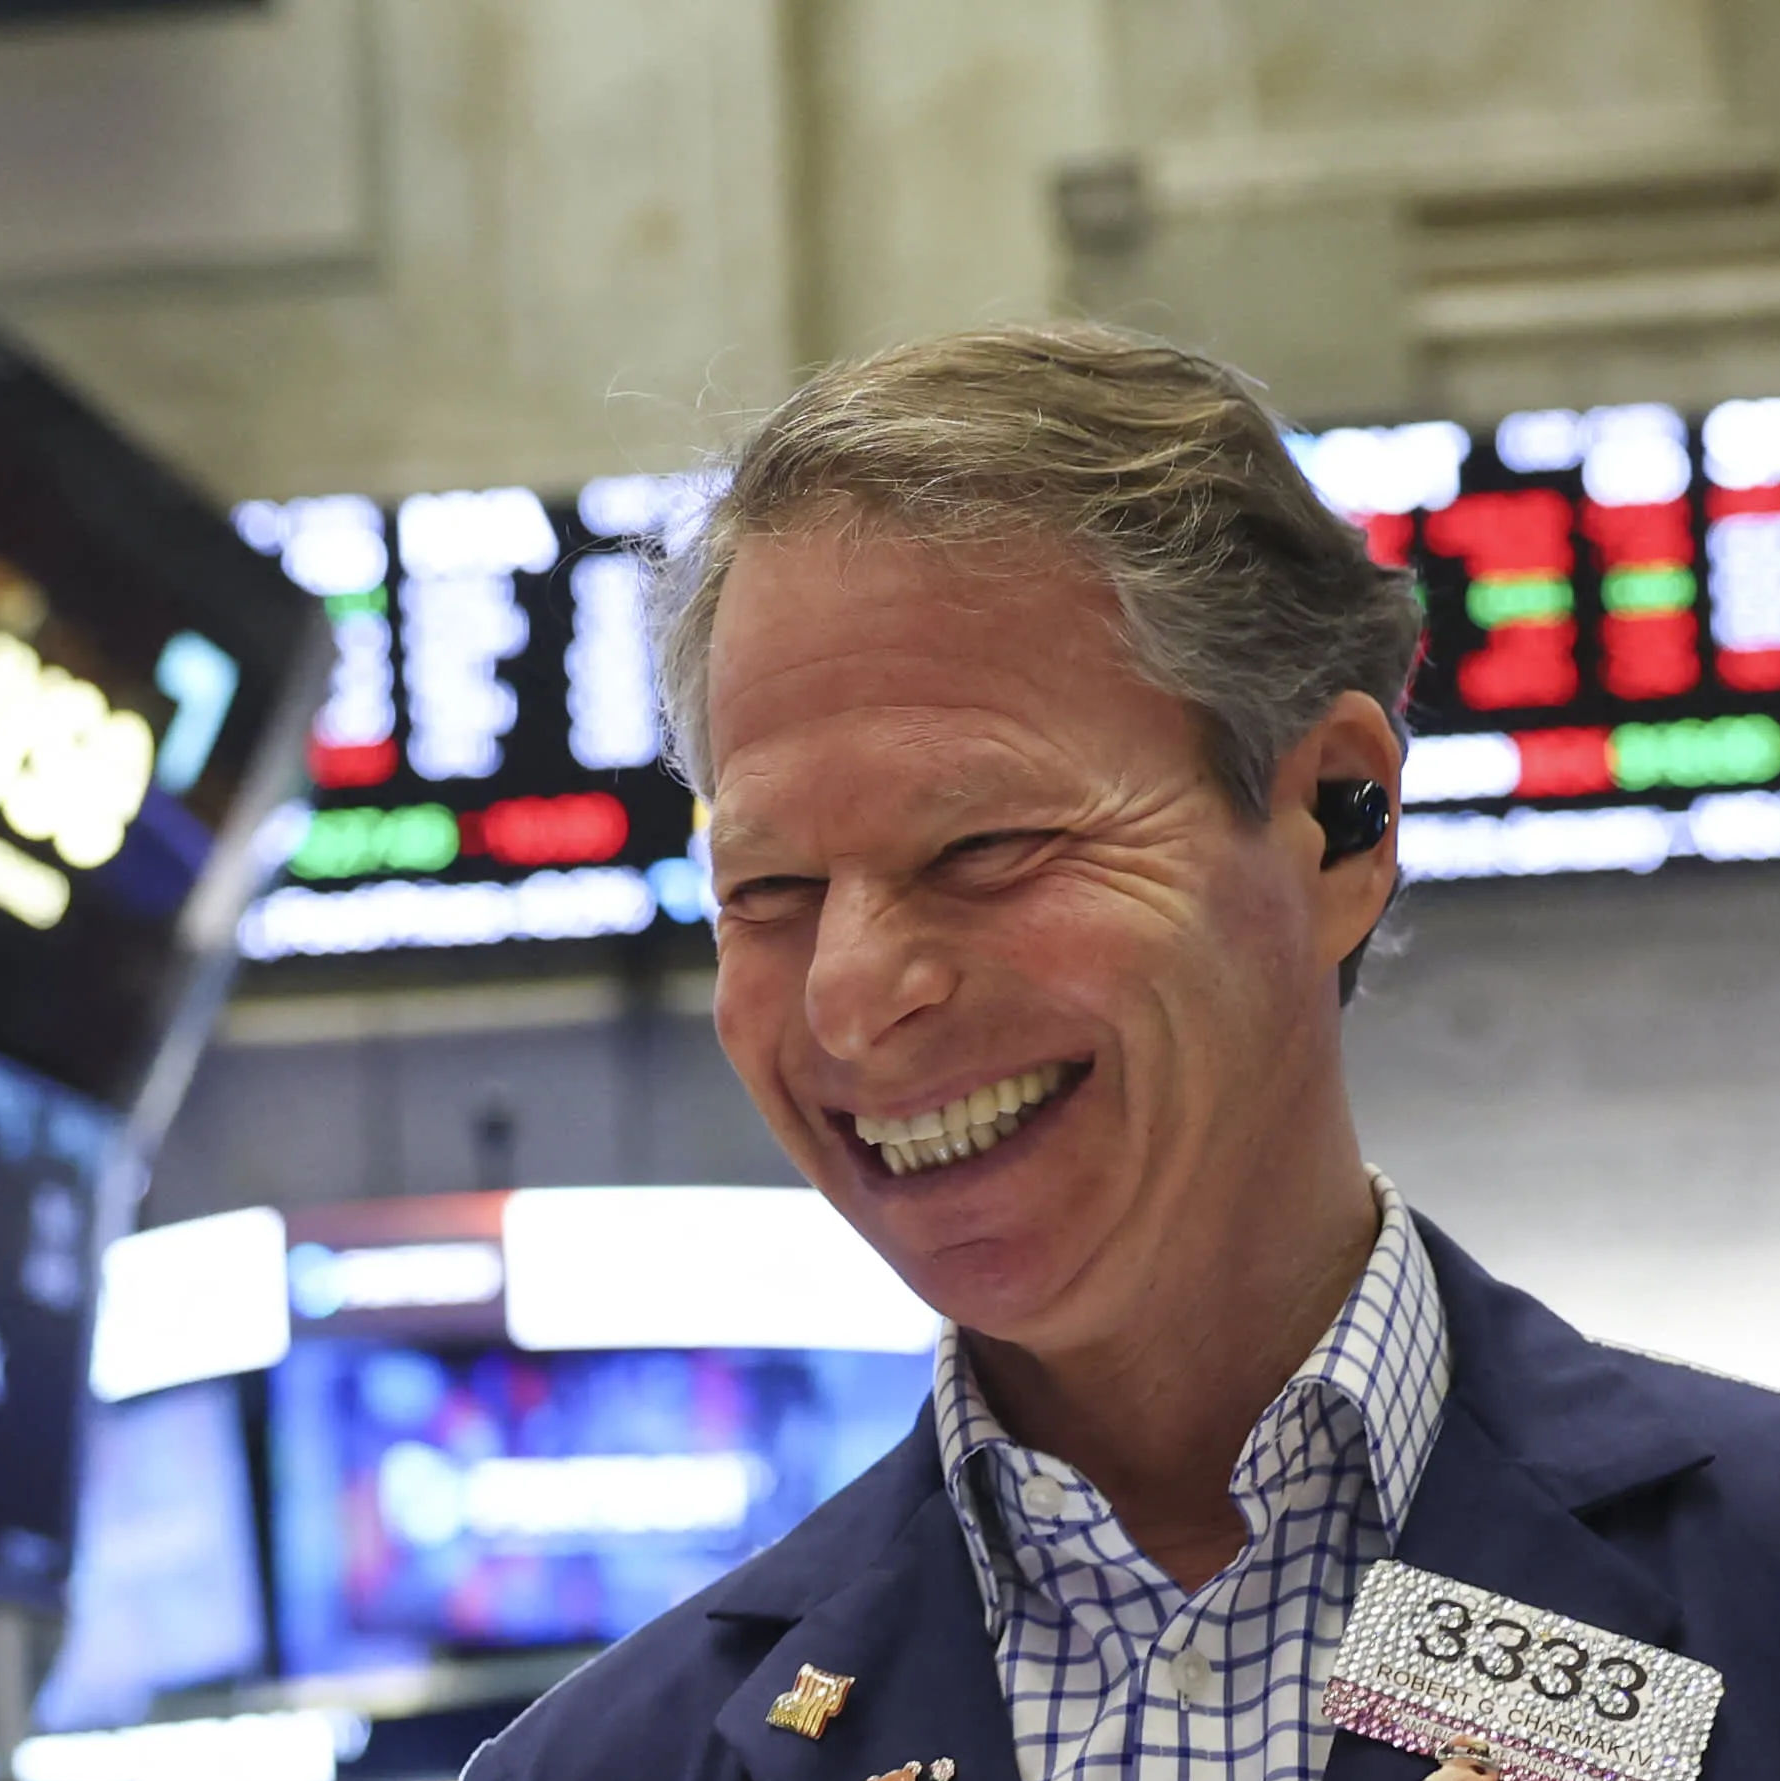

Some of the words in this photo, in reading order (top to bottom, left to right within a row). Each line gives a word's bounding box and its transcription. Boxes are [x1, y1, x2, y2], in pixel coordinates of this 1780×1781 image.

[1377, 1663, 1473, 1707] ROBERT
[1508, 1709, 1626, 1760] CHARMAK
[1629, 1751, 1654, 1767] IV
[1415, 1600, 1648, 1721] 3333
